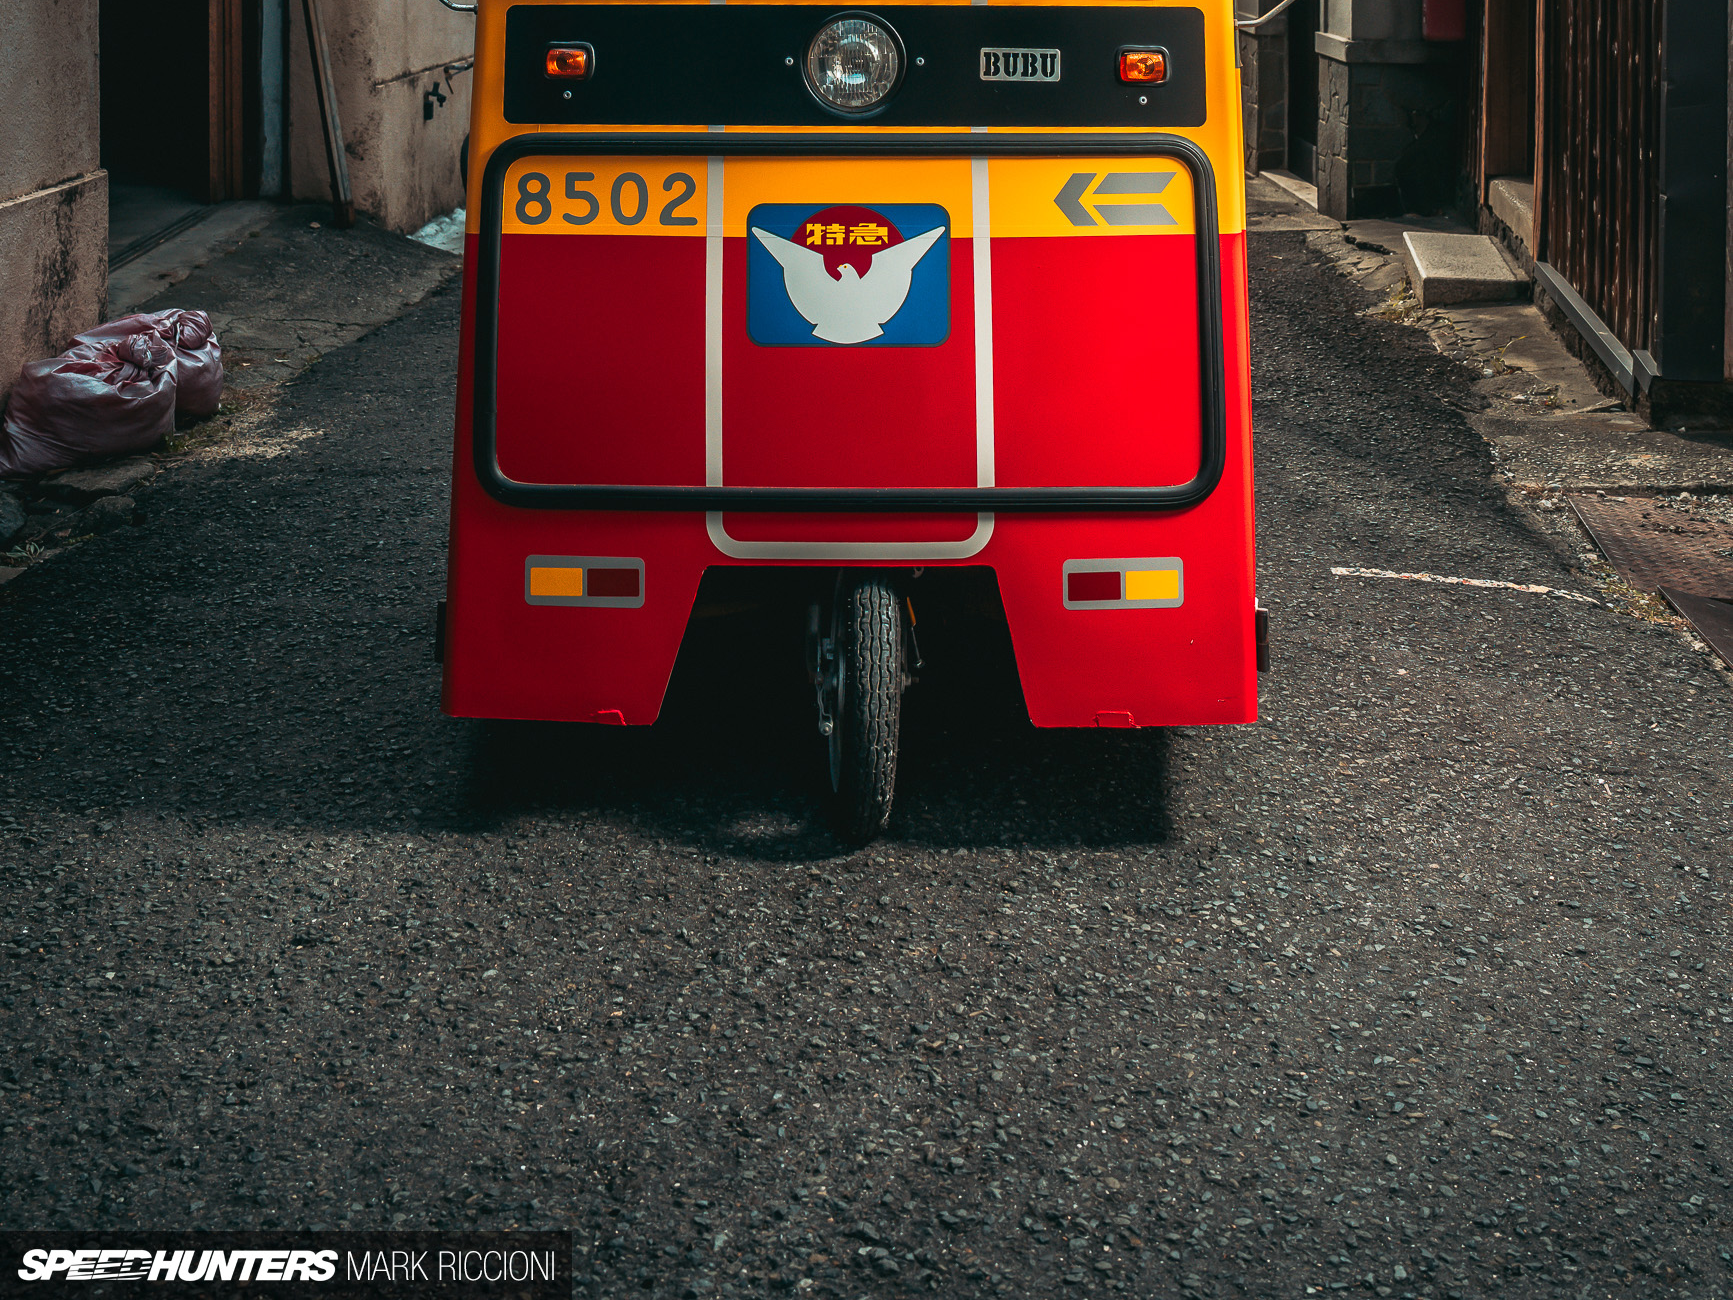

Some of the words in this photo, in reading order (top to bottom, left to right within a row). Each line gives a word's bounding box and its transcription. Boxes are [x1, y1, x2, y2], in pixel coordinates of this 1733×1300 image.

[983, 52, 1057, 78] BUBU
[515, 172, 698, 226] 8502
[806, 222, 889, 246] 特急
